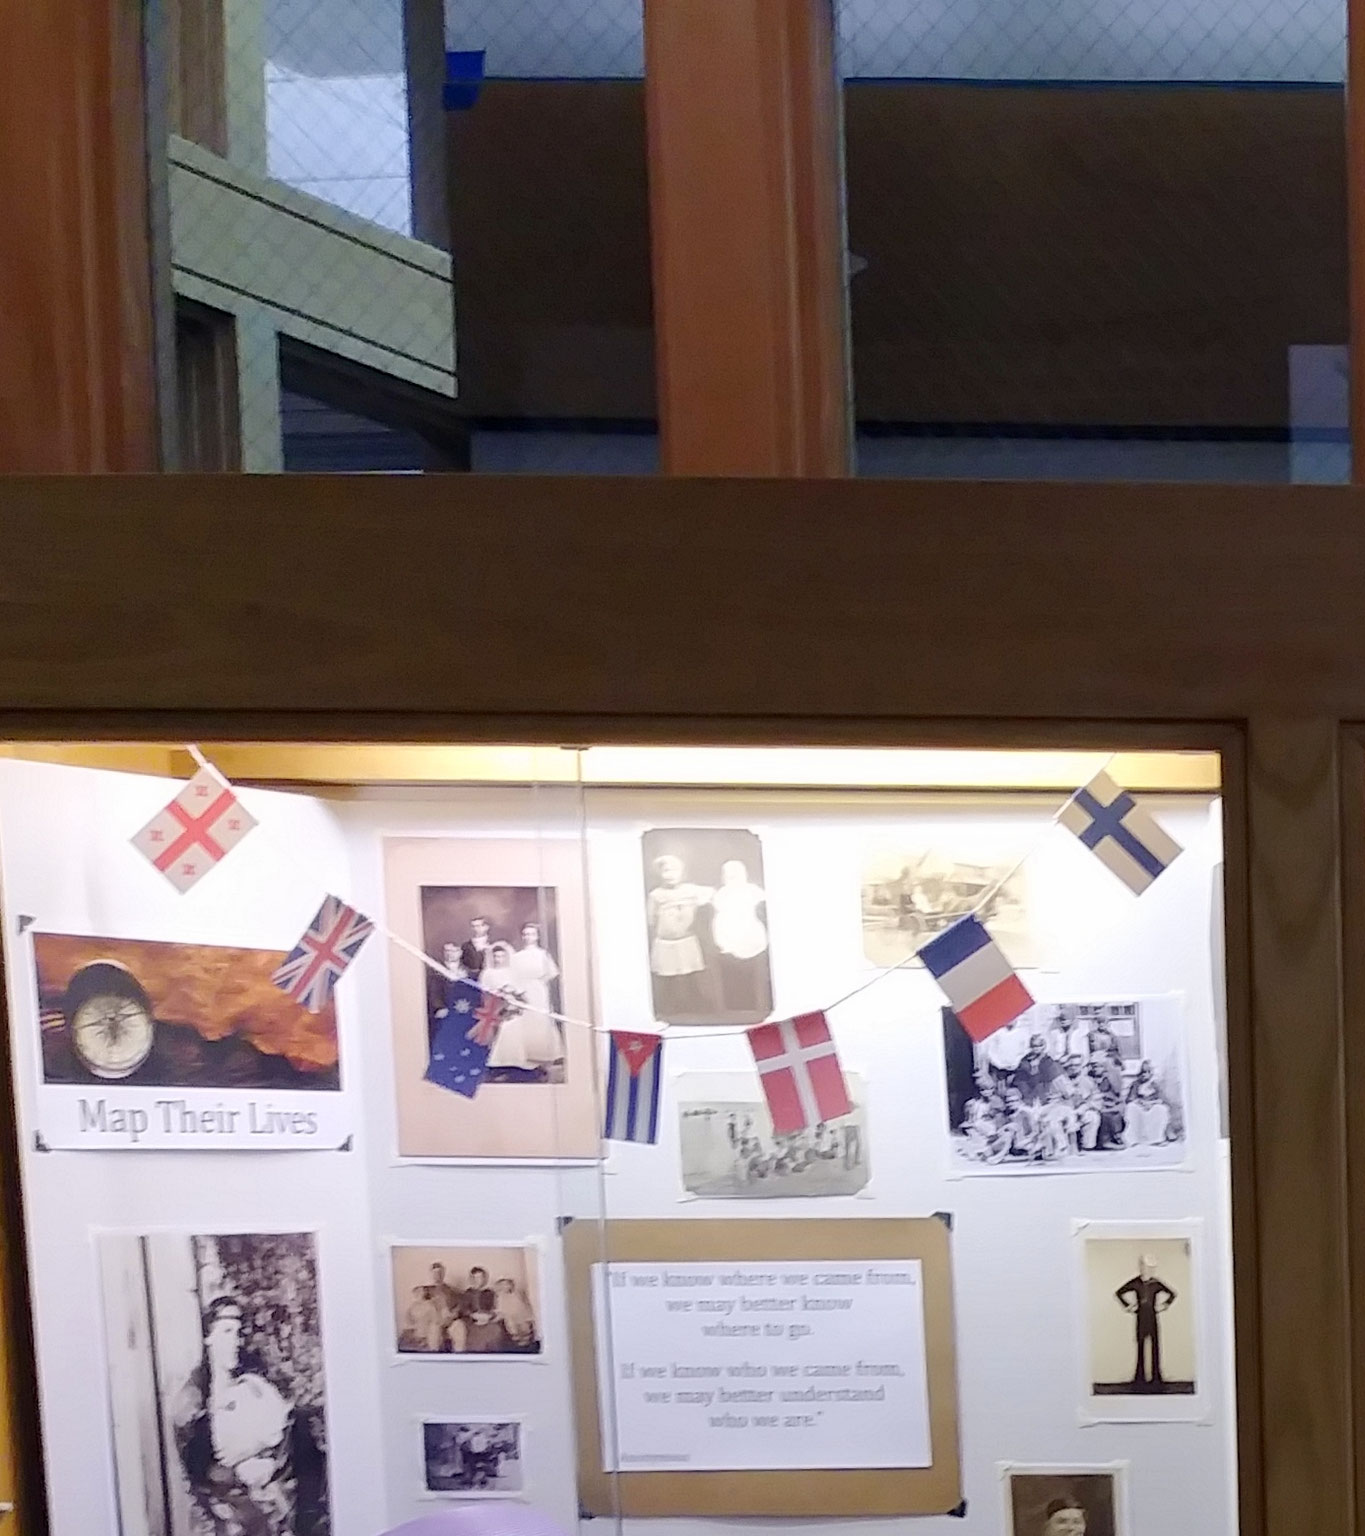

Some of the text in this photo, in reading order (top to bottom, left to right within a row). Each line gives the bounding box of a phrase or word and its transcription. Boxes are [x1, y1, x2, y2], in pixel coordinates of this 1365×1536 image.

[77, 1099, 318, 1142] Map Their Lives
[630, 1275, 659, 1288] we
[661, 1270, 714, 1288] know
[719, 1269, 777, 1287] where
[780, 1274, 809, 1286] we
[813, 1274, 863, 1287] came
[665, 1294, 854, 1316] we may better know
[701, 1320, 762, 1337] where
[763, 1323, 785, 1337] to
[639, 1366, 668, 1378] we
[670, 1361, 721, 1379] know
[725, 1361, 768, 1378] who
[769, 1365, 799, 1378] we
[803, 1365, 850, 1377] came
[643, 1383, 886, 1408] we may better understand
[708, 1411, 749, 1429] who
[750, 1415, 779, 1428] we
